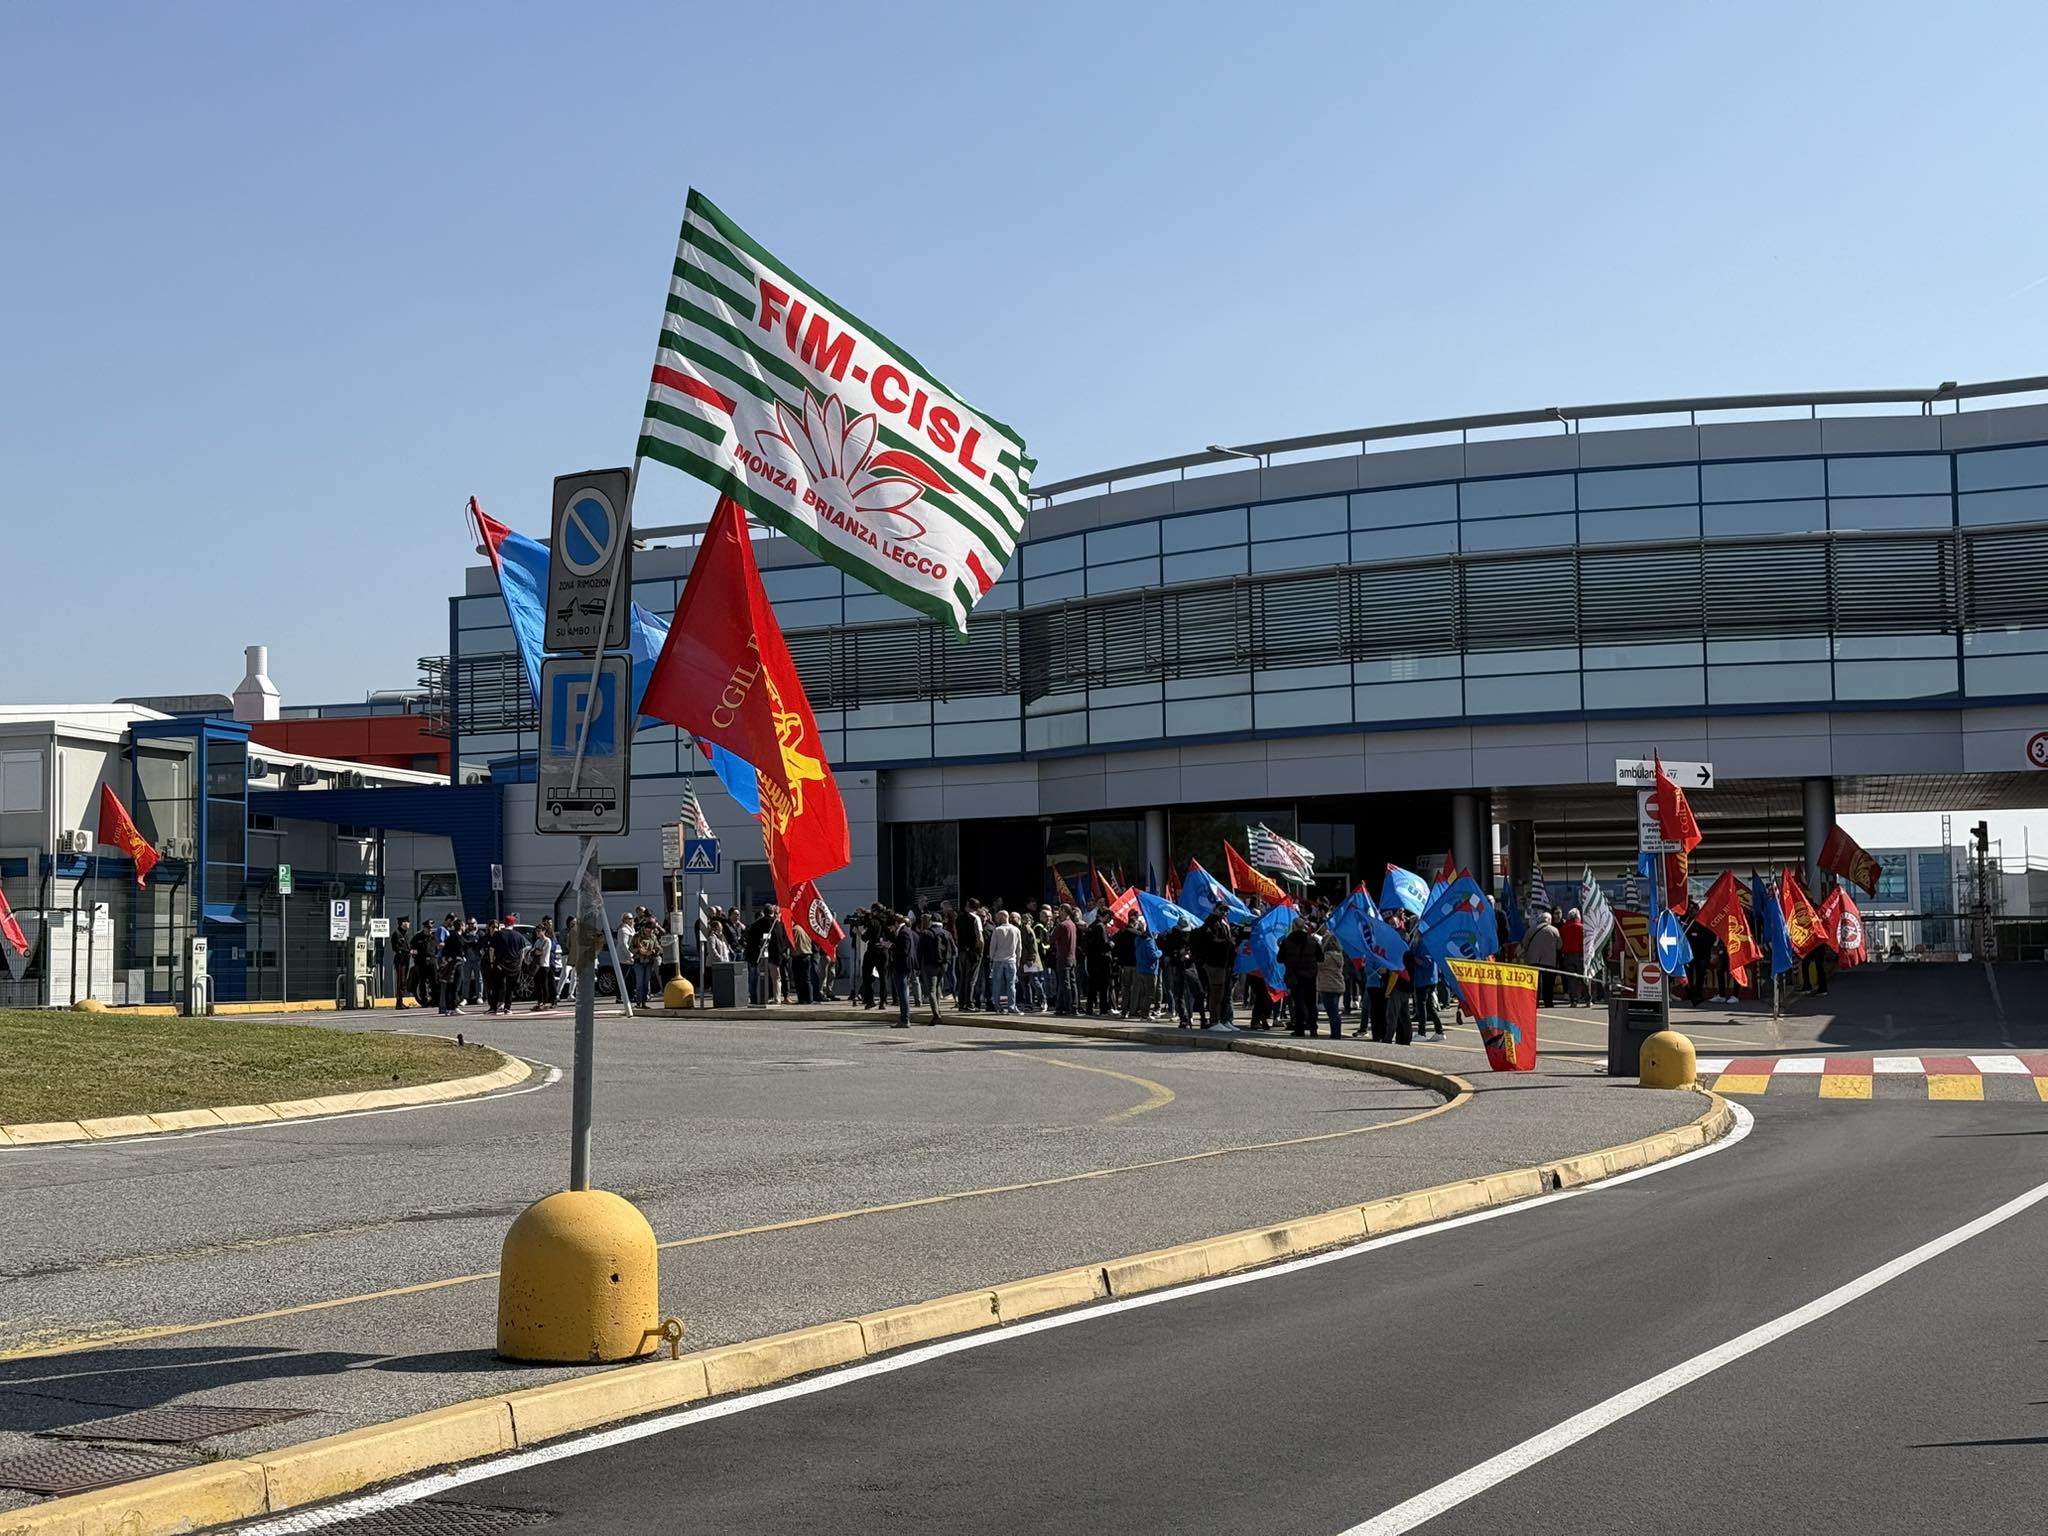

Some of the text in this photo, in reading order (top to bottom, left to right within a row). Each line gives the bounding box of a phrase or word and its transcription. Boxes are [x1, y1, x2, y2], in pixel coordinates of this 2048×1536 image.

[758, 279, 987, 480] FIM-CISL
[733, 443, 948, 581] MONZA BRIANZA LECCO
[559, 577, 611, 591] ZONA RIMOZION
[556, 627, 566, 637] SU
[567, 626, 590, 636] AMBO
[711, 660, 762, 728] CGIL
[566, 682, 603, 751] P
[1619, 766, 1657, 779] ambulan
[336, 903, 345, 917] P
